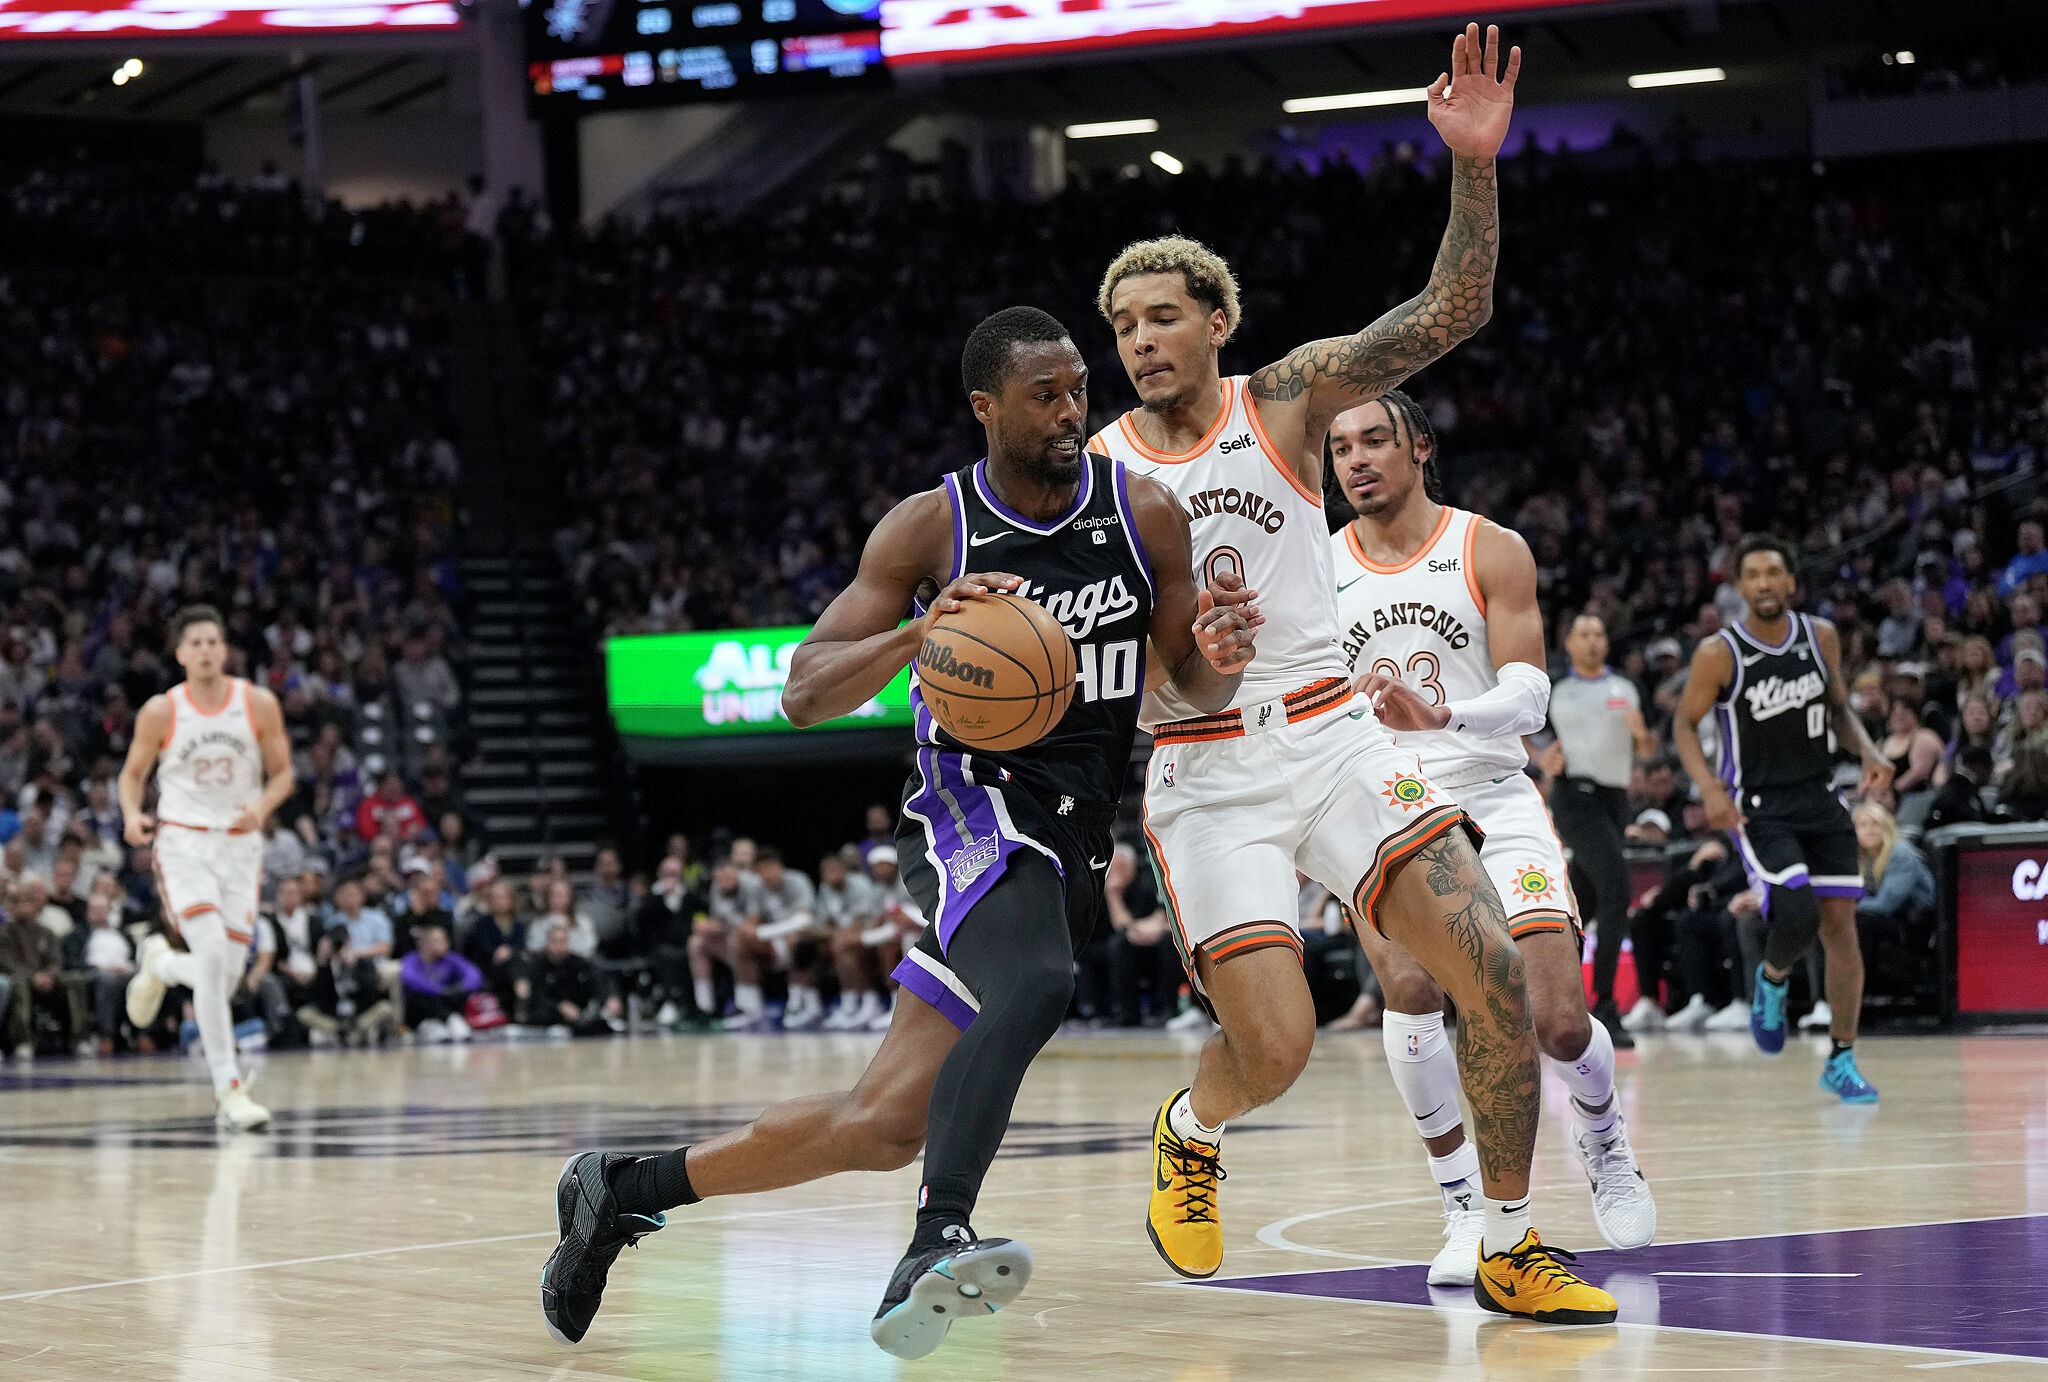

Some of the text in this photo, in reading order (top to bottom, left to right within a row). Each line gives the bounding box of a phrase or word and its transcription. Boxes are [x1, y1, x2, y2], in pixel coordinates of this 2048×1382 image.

[1219, 433, 1256, 454] Self.
[1072, 513, 1119, 530] dialpad
[1428, 558, 1461, 572] Self.
[997, 575, 1138, 639] ngs
[1373, 602, 1469, 649] ANTONIO
[920, 637, 995, 690] Wilson
[1745, 670, 1825, 721] Kings
[193, 757, 233, 785] 23
